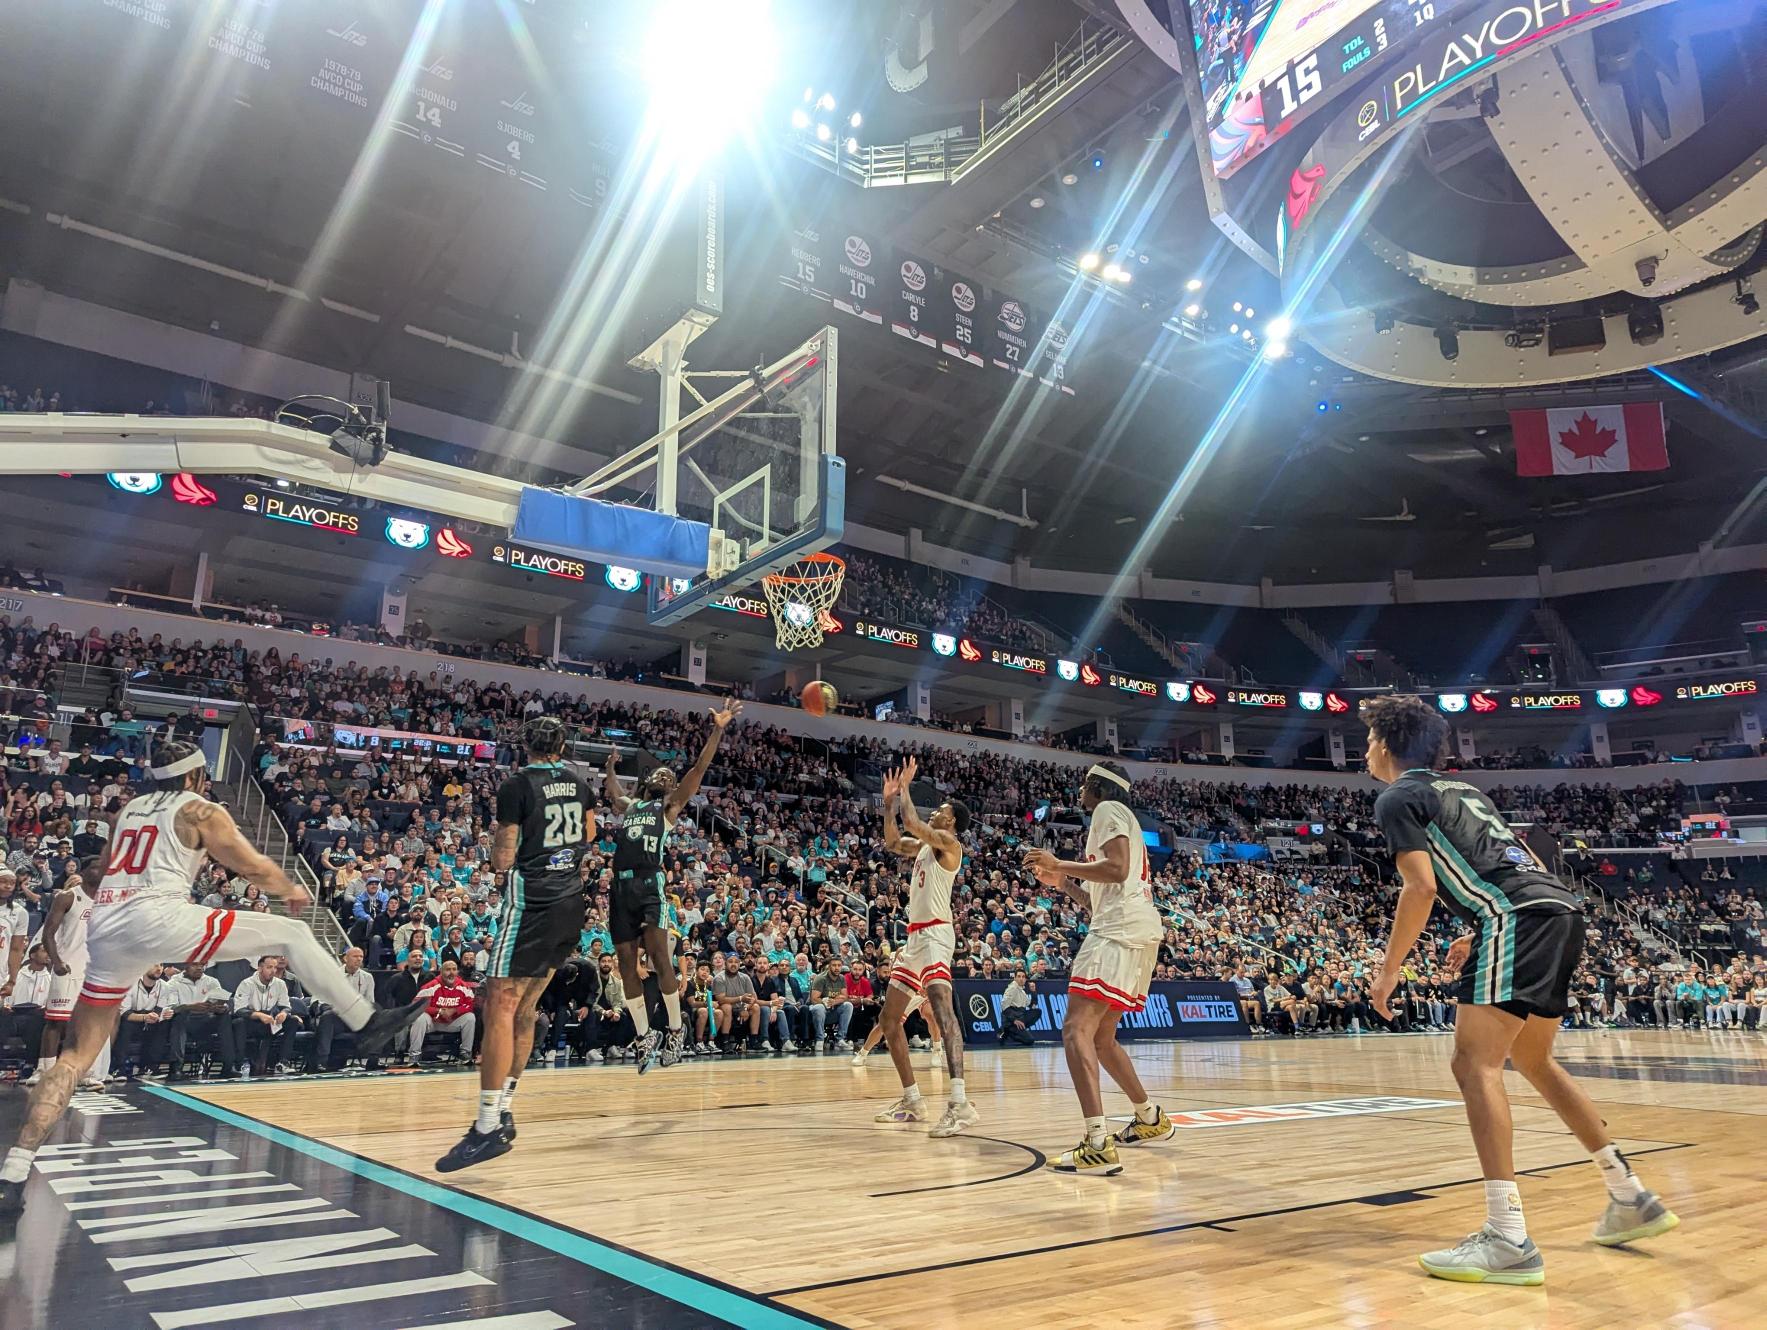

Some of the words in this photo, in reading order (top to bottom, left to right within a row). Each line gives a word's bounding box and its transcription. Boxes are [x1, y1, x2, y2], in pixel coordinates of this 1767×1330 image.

[1413, 3, 1435, 27] 1Q
[1373, 17, 1386, 36] 2
[246, 38, 267, 54] CUP
[1342, 35, 1365, 54] TOL
[1376, 33, 1389, 51] 3
[208, 36, 271, 70] CHAMPIONS
[1341, 46, 1371, 73] FOULS
[1393, 0, 1606, 111] PLAYOF
[318, 69, 343, 86] AVCO
[344, 76, 363, 92] CUP
[1276, 53, 1322, 119] 15
[310, 77, 368, 108] CHAMPIONS
[415, 101, 442, 128] 14
[497, 120, 535, 144] SJOBERG
[506, 140, 521, 161] 4
[797, 262, 815, 283] 15
[849, 279, 866, 299] 10
[902, 290, 926, 307] CARLYLE
[909, 305, 919, 321] 8
[955, 313, 973, 327] STEEN
[956, 325, 972, 344] 25
[1005, 344, 1020, 361] 27
[266, 499, 359, 531] PLAYOFFS
[511, 550, 585, 577] PLAYOFFS
[715, 595, 768, 615] AYOFFS
[868, 624, 918, 646] PLAYOFFS
[437, 662, 455, 672] 218
[1002, 652, 1046, 672] PLAYOFFS
[1118, 676, 1157, 694] PLAYOFFS
[1691, 680, 1757, 697] PLAYOFFS
[1238, 692, 1286, 705] PLAYOFFS
[1524, 695, 1581, 706] PLAYOFFS
[542, 782, 577, 800] HARRIS
[543, 801, 583, 848] 20
[643, 834, 659, 853] 13
[918, 870, 926, 889] 3
[435, 996, 461, 1006] SURGE
[972, 1022, 995, 1032] CEBL
[33, 1136, 577, 1330] INNIPEG
